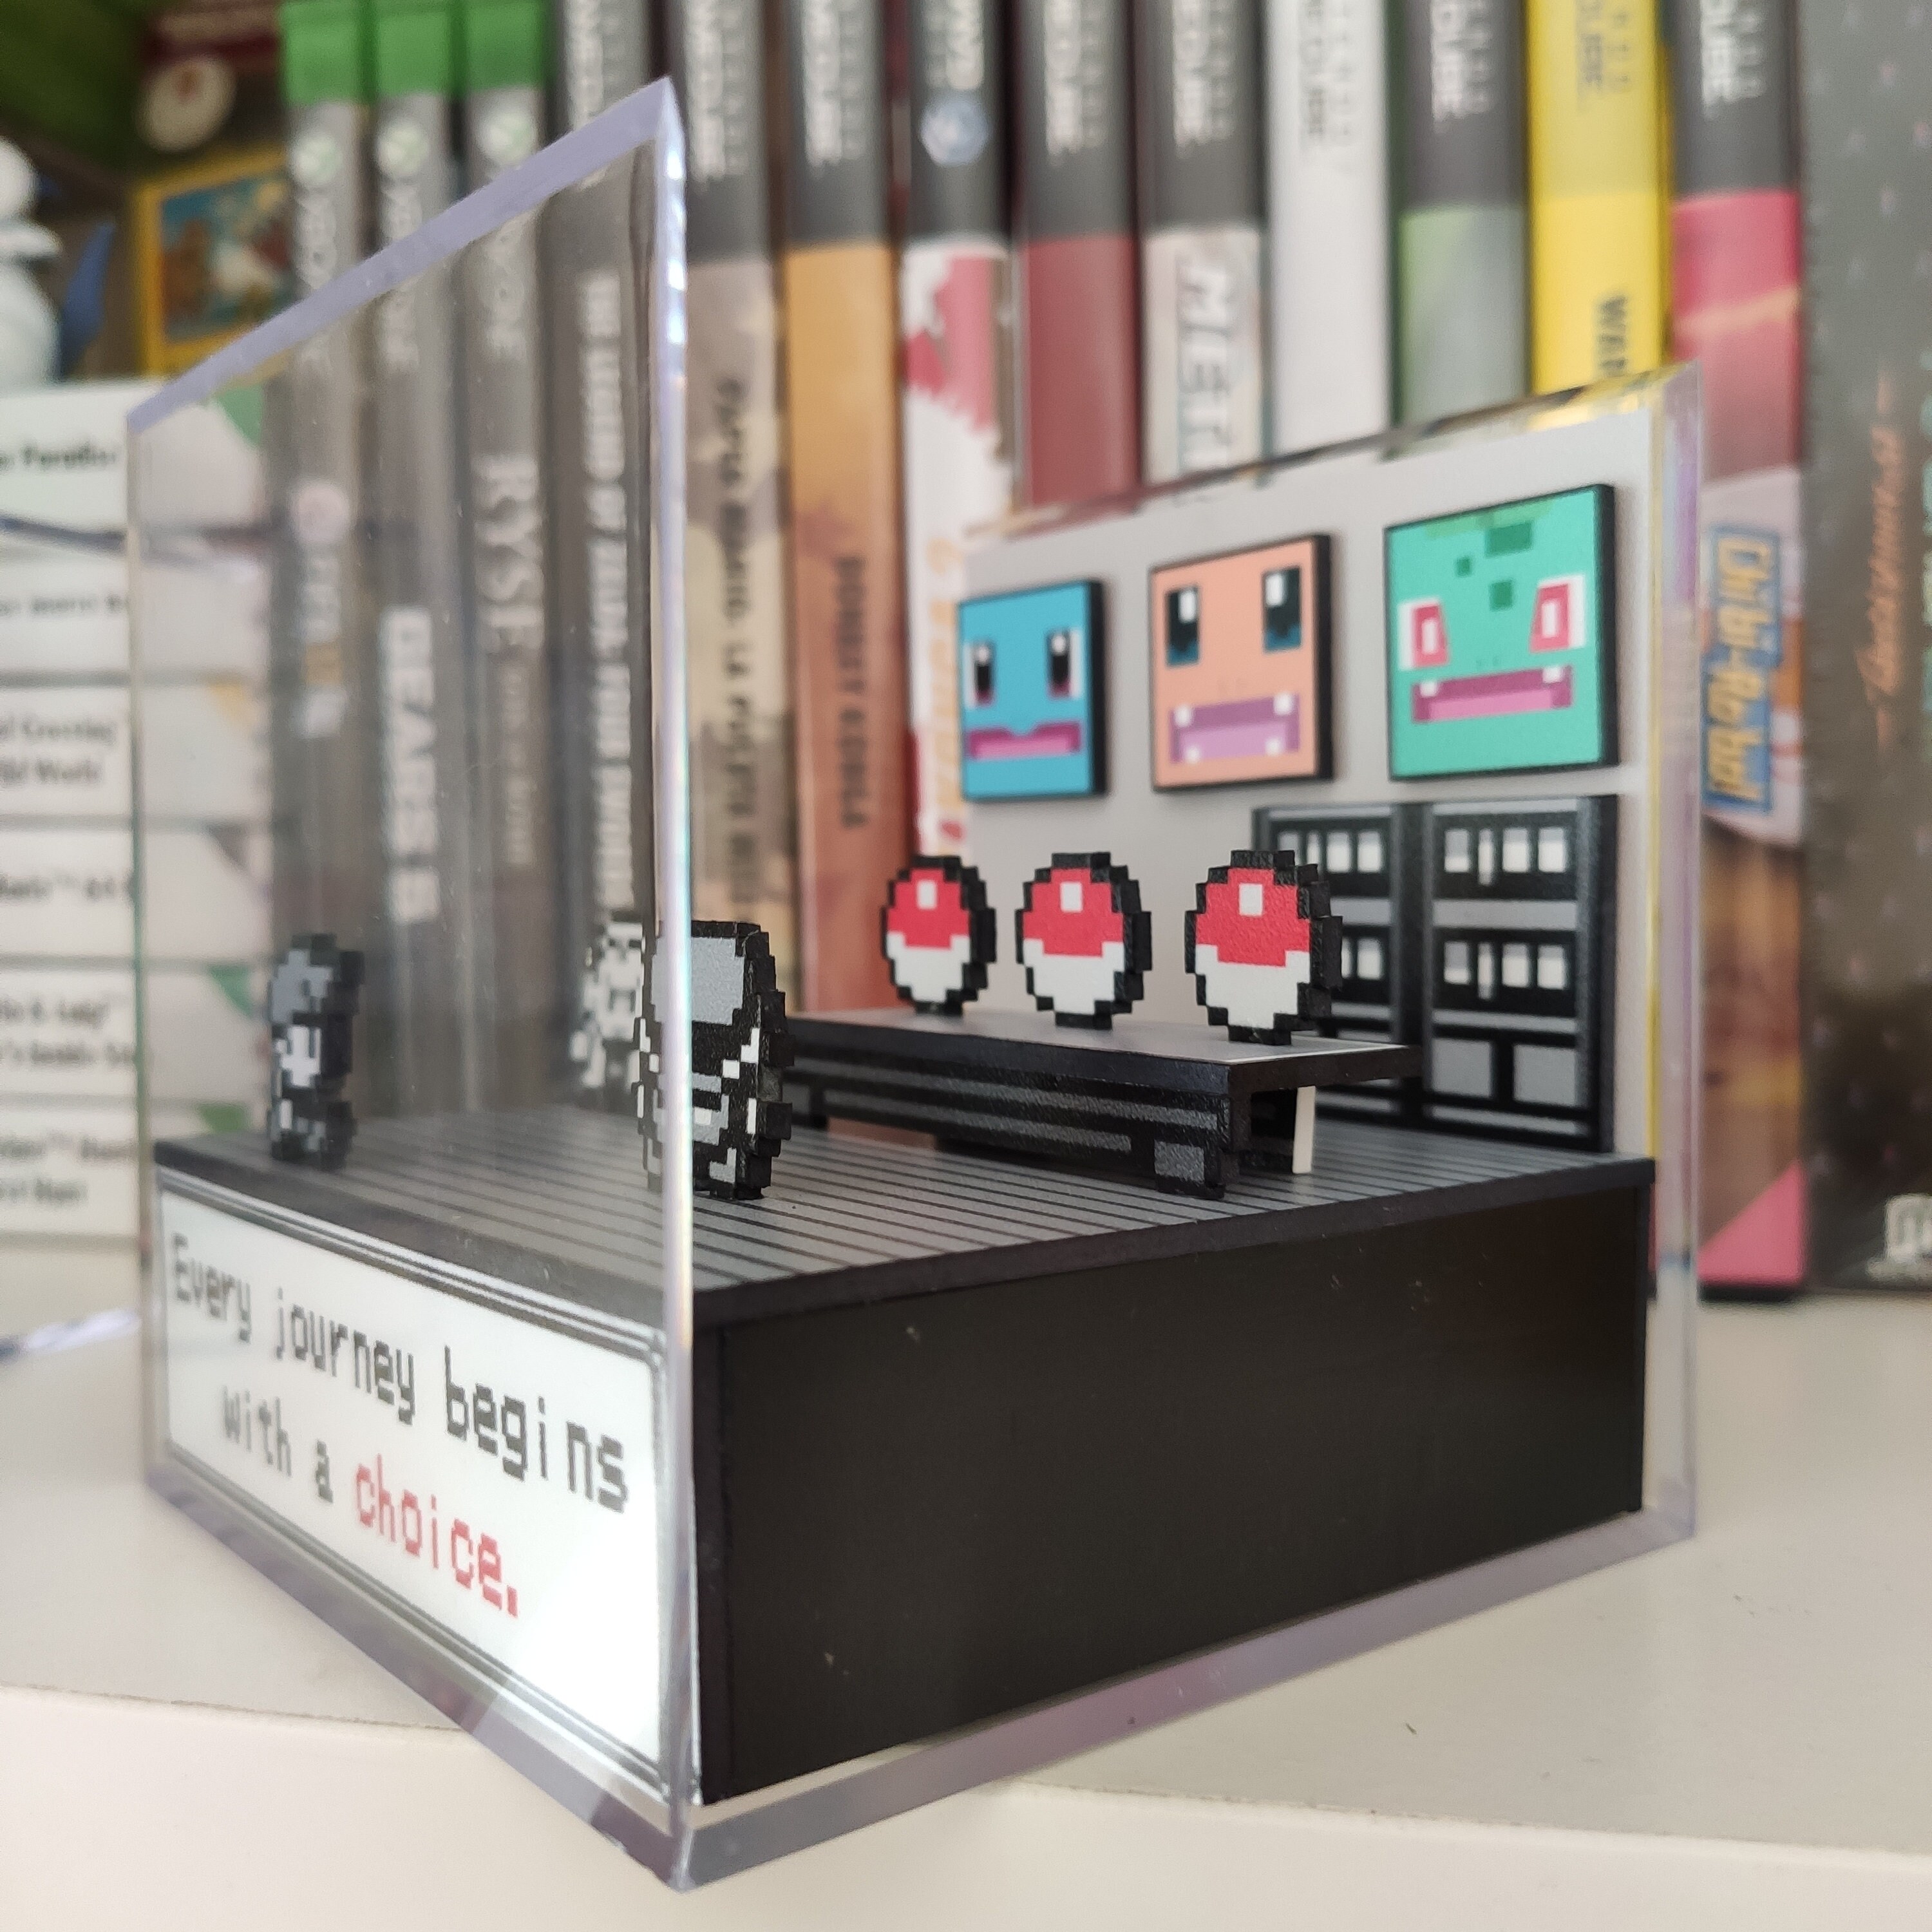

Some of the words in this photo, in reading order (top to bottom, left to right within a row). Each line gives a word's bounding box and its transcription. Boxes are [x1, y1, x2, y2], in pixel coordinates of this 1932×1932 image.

[173, 1231, 252, 1344] Every
[274, 1287, 416, 1426] journey
[444, 1344, 628, 1514] begins
[223, 1385, 292, 1477] with
[314, 1439, 334, 1502] a
[355, 1452, 519, 1619] choice.
